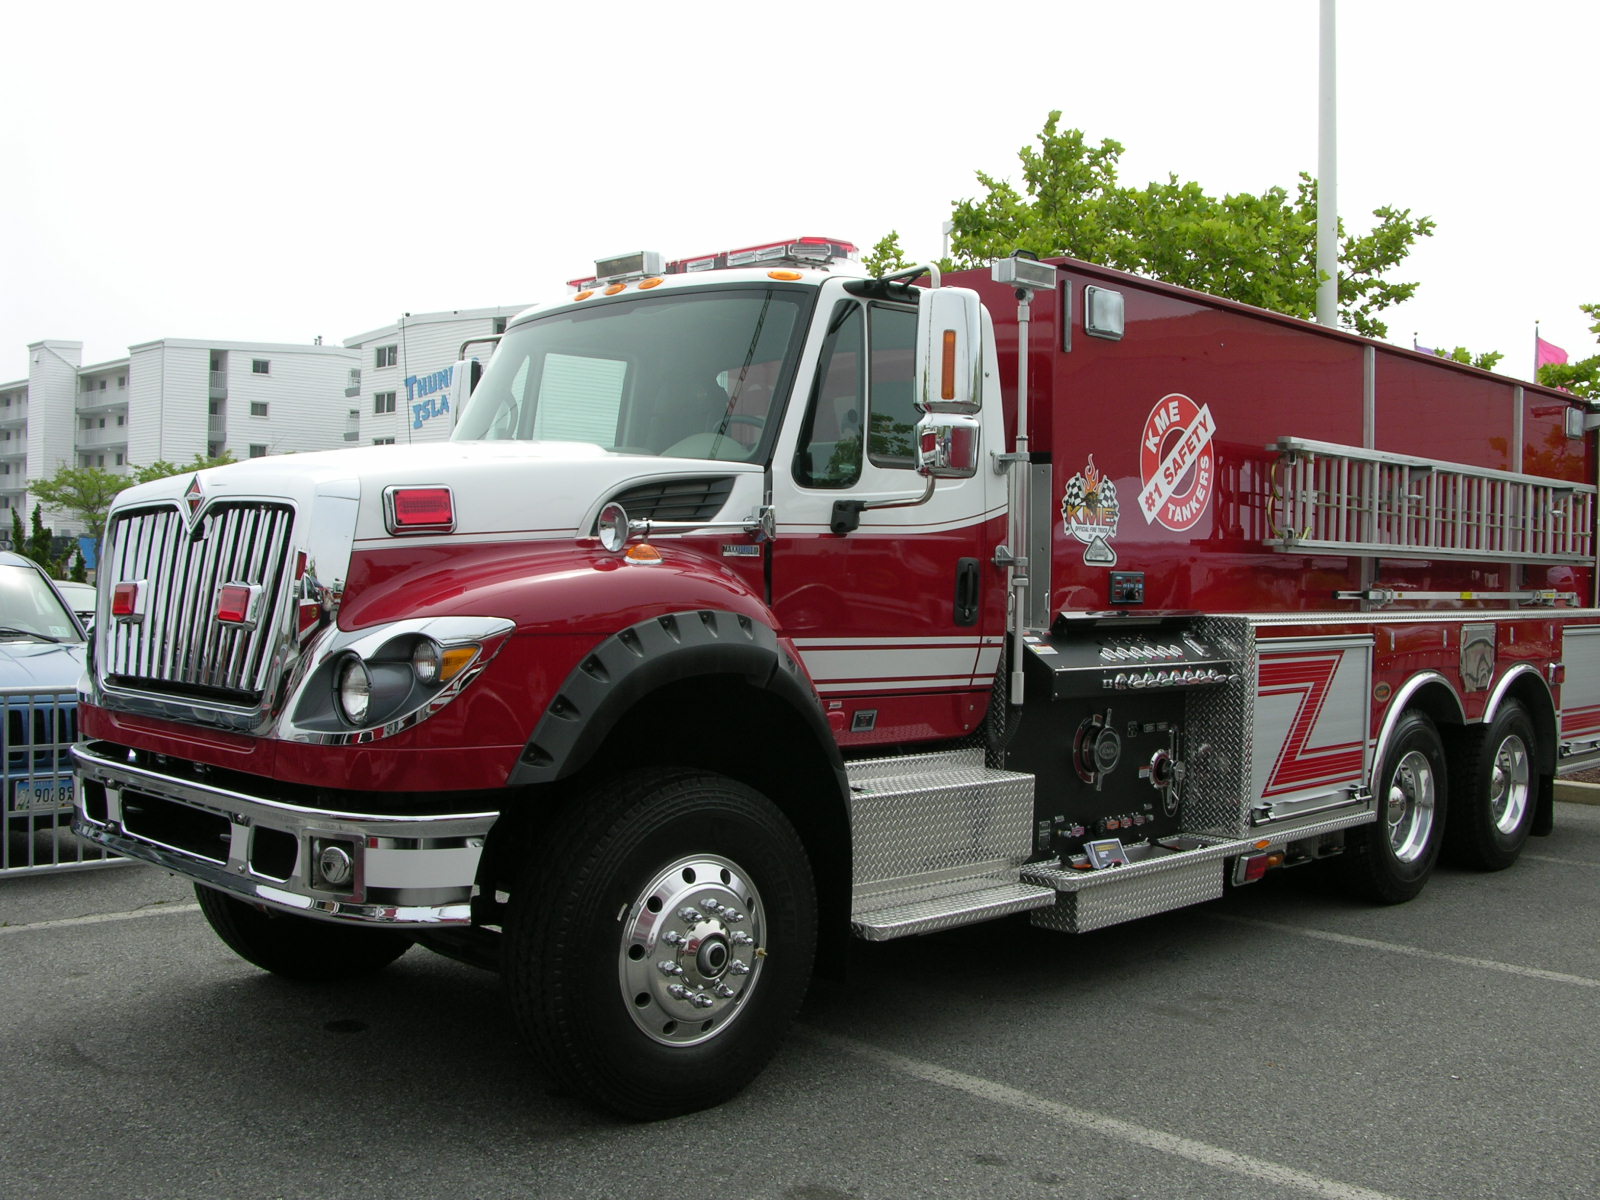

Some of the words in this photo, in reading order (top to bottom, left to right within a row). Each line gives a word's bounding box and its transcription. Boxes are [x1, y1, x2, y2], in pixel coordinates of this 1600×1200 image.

[1145, 401, 1180, 454] KME
[1145, 483, 1163, 512] #1
[1163, 414, 1210, 486] SAFETY
[1167, 455, 1209, 522] TANKERS
[1066, 505, 1116, 526] KME
